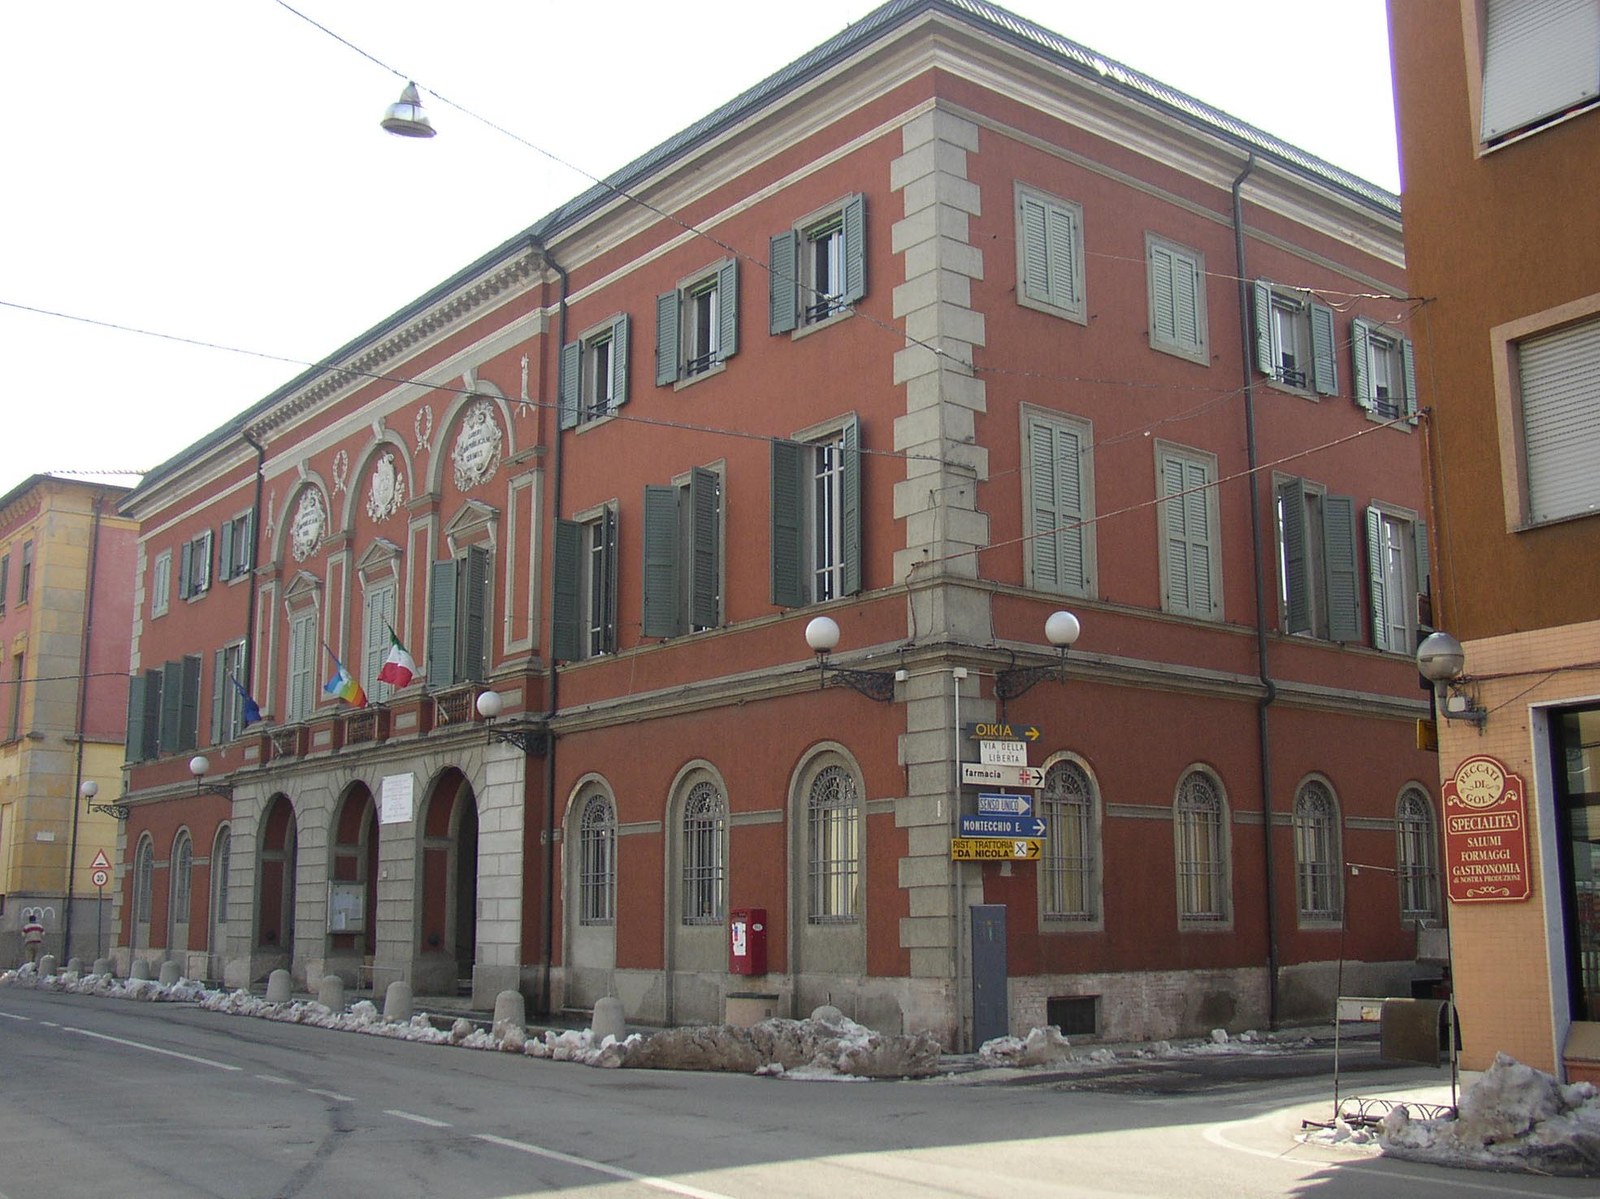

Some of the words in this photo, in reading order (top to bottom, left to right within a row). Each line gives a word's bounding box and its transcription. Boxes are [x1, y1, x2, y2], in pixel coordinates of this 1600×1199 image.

[975, 723, 1012, 736] OIKIA
[1001, 743, 1024, 751] DELLA
[965, 768, 1001, 778] farmacia
[1459, 764, 1500, 784] PECCATI
[1474, 780, 1485, 788] DI
[1466, 792, 1495, 804] GOLA
[980, 799, 999, 810] SENSO
[1001, 799, 1019, 811] UNICO
[963, 820, 1011, 832] MONTECCHIO
[1015, 822, 1022, 832] E.
[1452, 814, 1516, 832] SPECIALITA'
[953, 840, 971, 849] RIST.
[974, 840, 1013, 849] TRATTORIA
[1467, 835, 1501, 847] SALUMI
[1461, 849, 1510, 861] FORMAGGI
[1452, 863, 1520, 876] GASTRONOMIA
